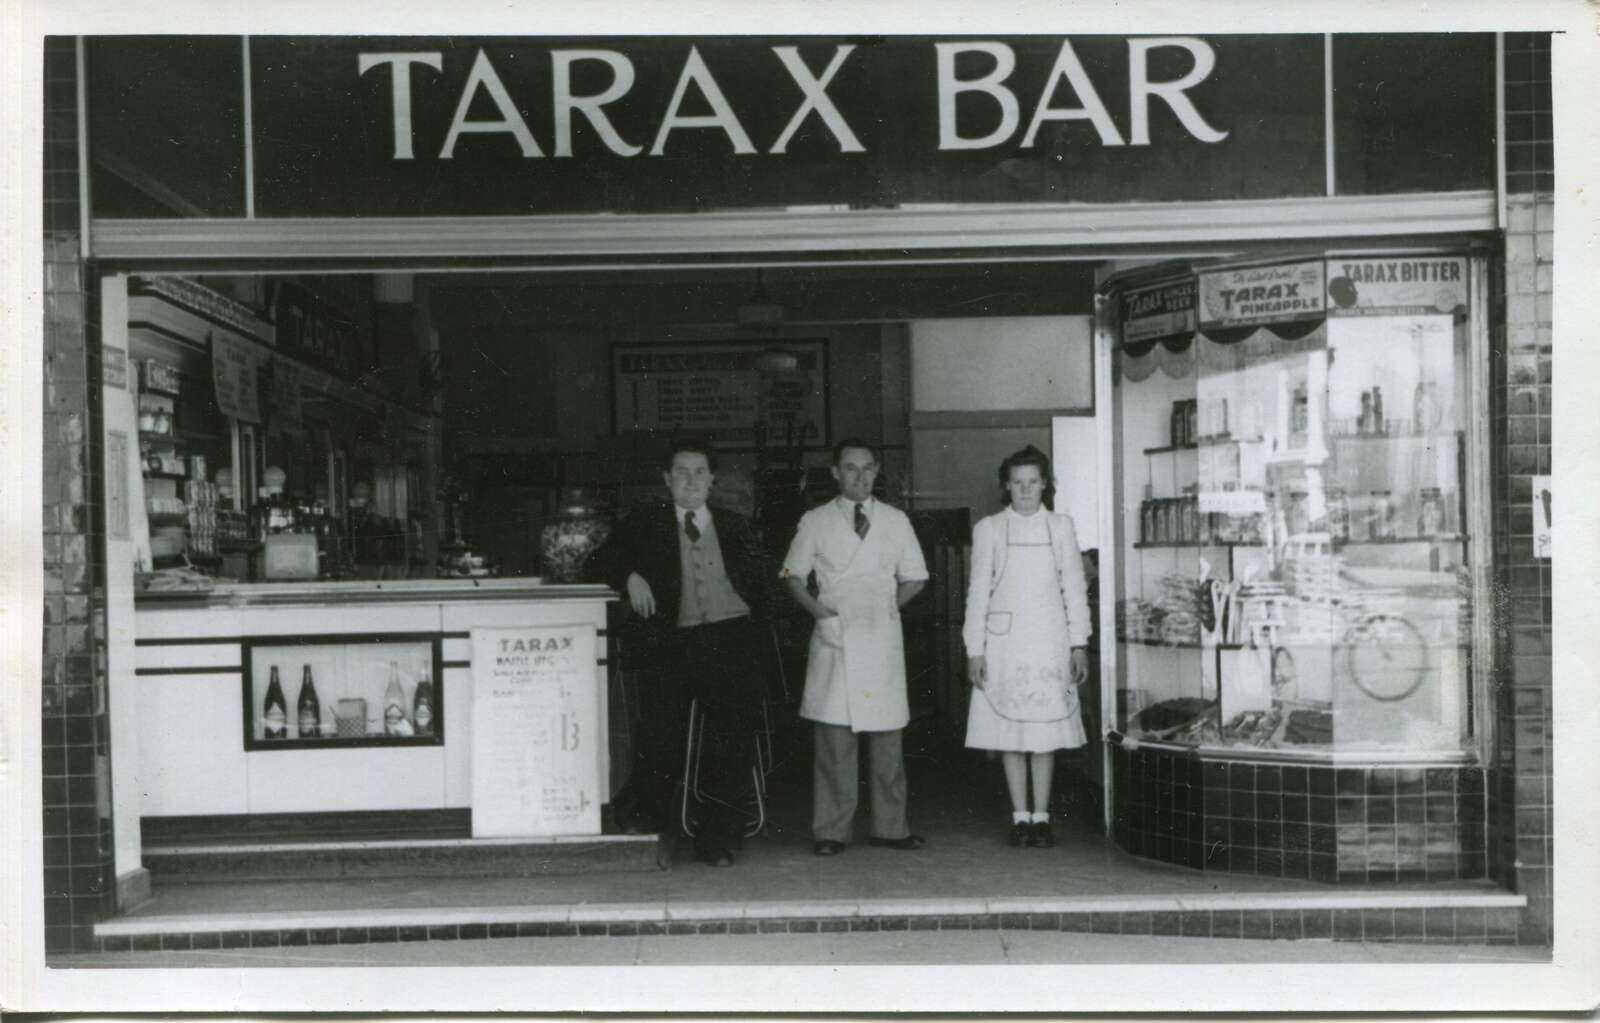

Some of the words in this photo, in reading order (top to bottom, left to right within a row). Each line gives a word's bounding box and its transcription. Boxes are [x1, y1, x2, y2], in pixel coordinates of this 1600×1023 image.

[358, 45, 867, 159] TARAX
[935, 37, 1230, 150] BAR
[1342, 262, 1398, 283] TARAX
[1401, 261, 1460, 281] BITTER
[1219, 283, 1299, 311] TARAX
[1240, 297, 1319, 315] PINEAPPLE
[501, 637, 575, 653] TARAX
